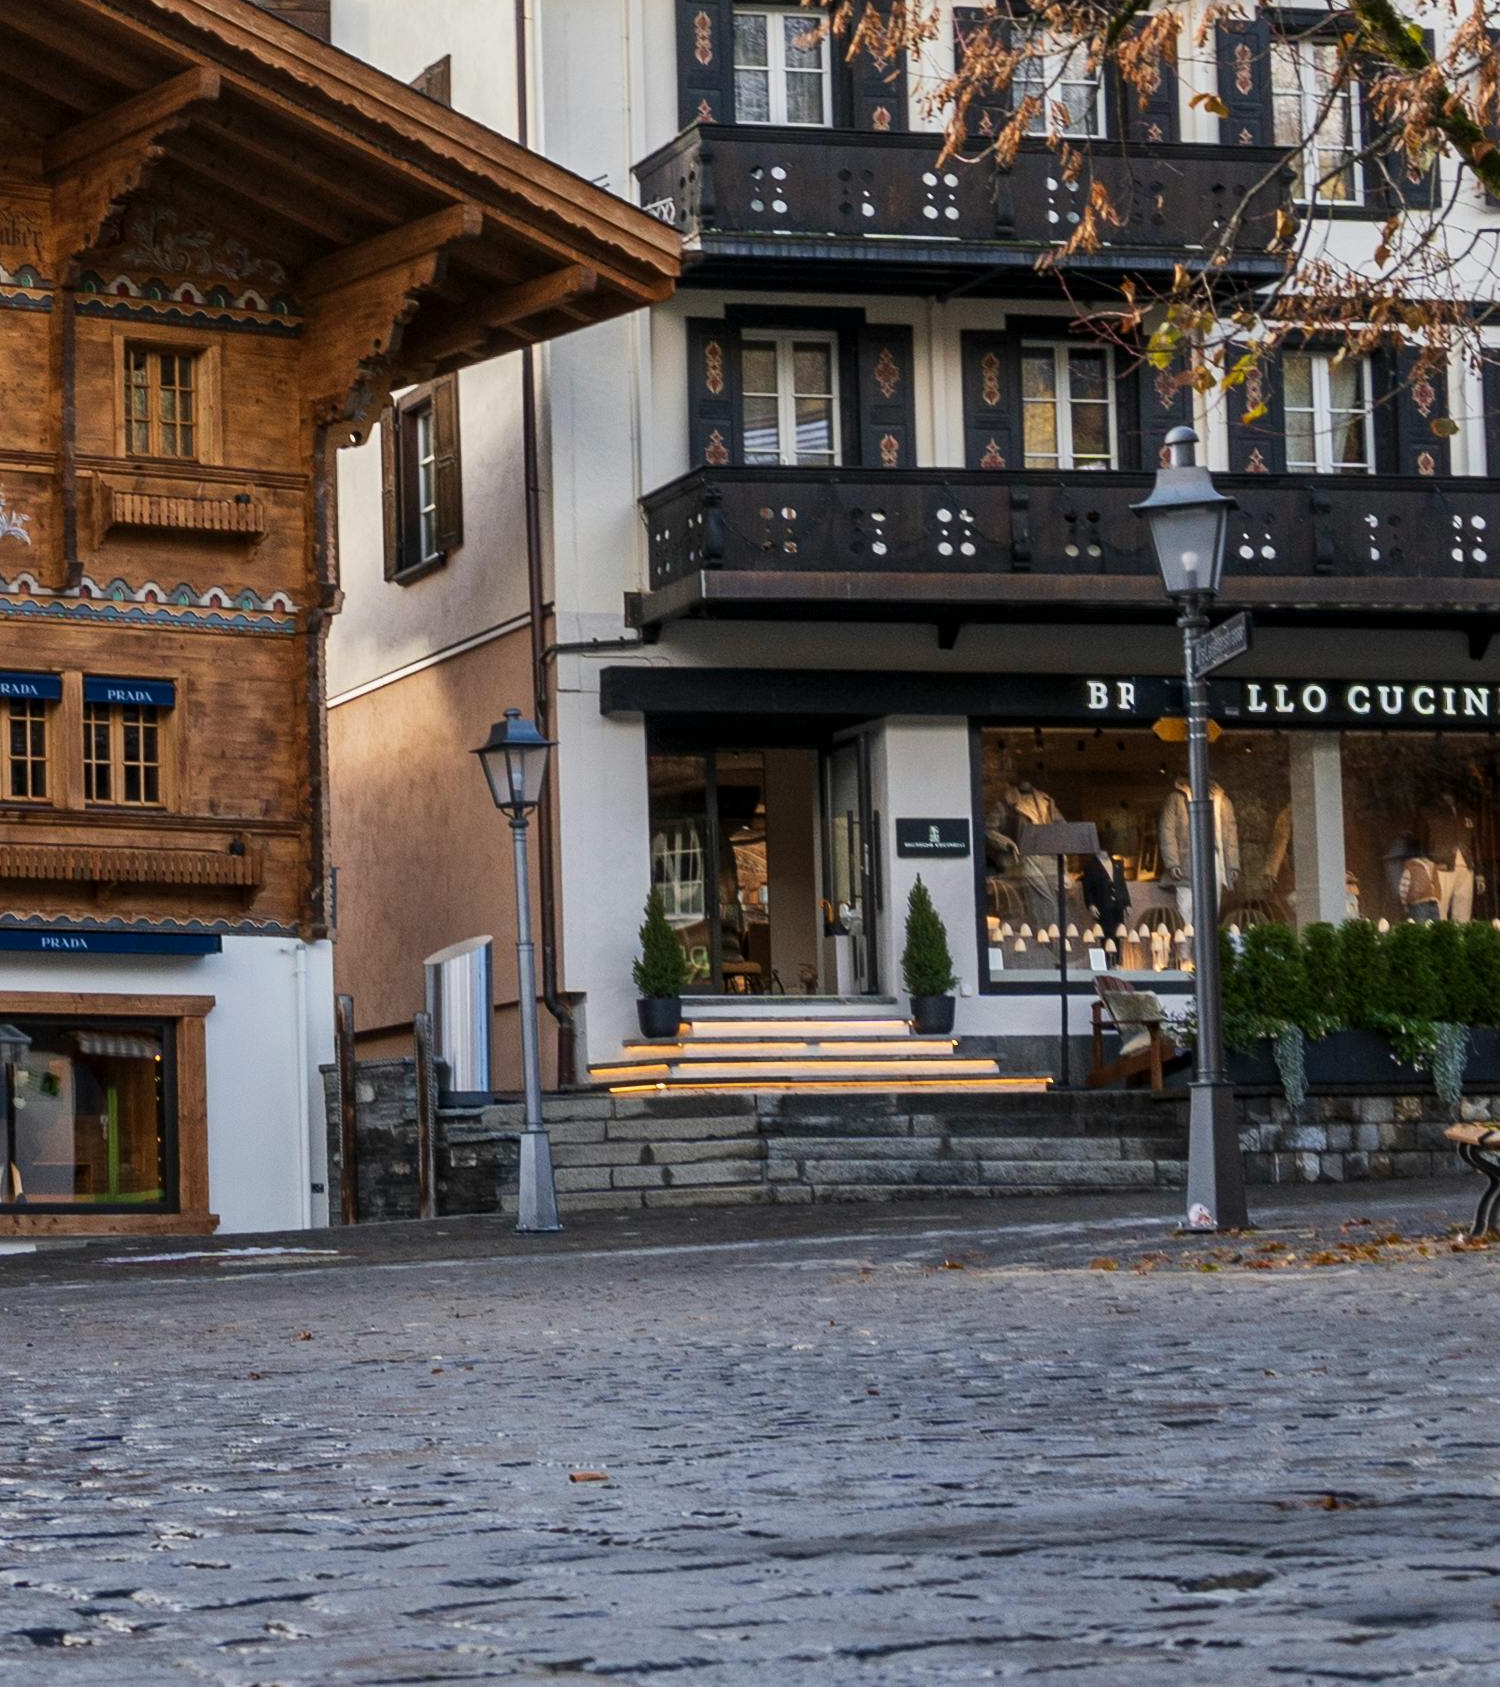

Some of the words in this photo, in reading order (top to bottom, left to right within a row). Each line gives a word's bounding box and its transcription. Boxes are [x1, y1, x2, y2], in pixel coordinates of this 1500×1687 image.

[107, 689, 153, 702] PRADA
[1086, 680, 1327, 713] BRLLO
[41, 937, 88, 949] PRADA
